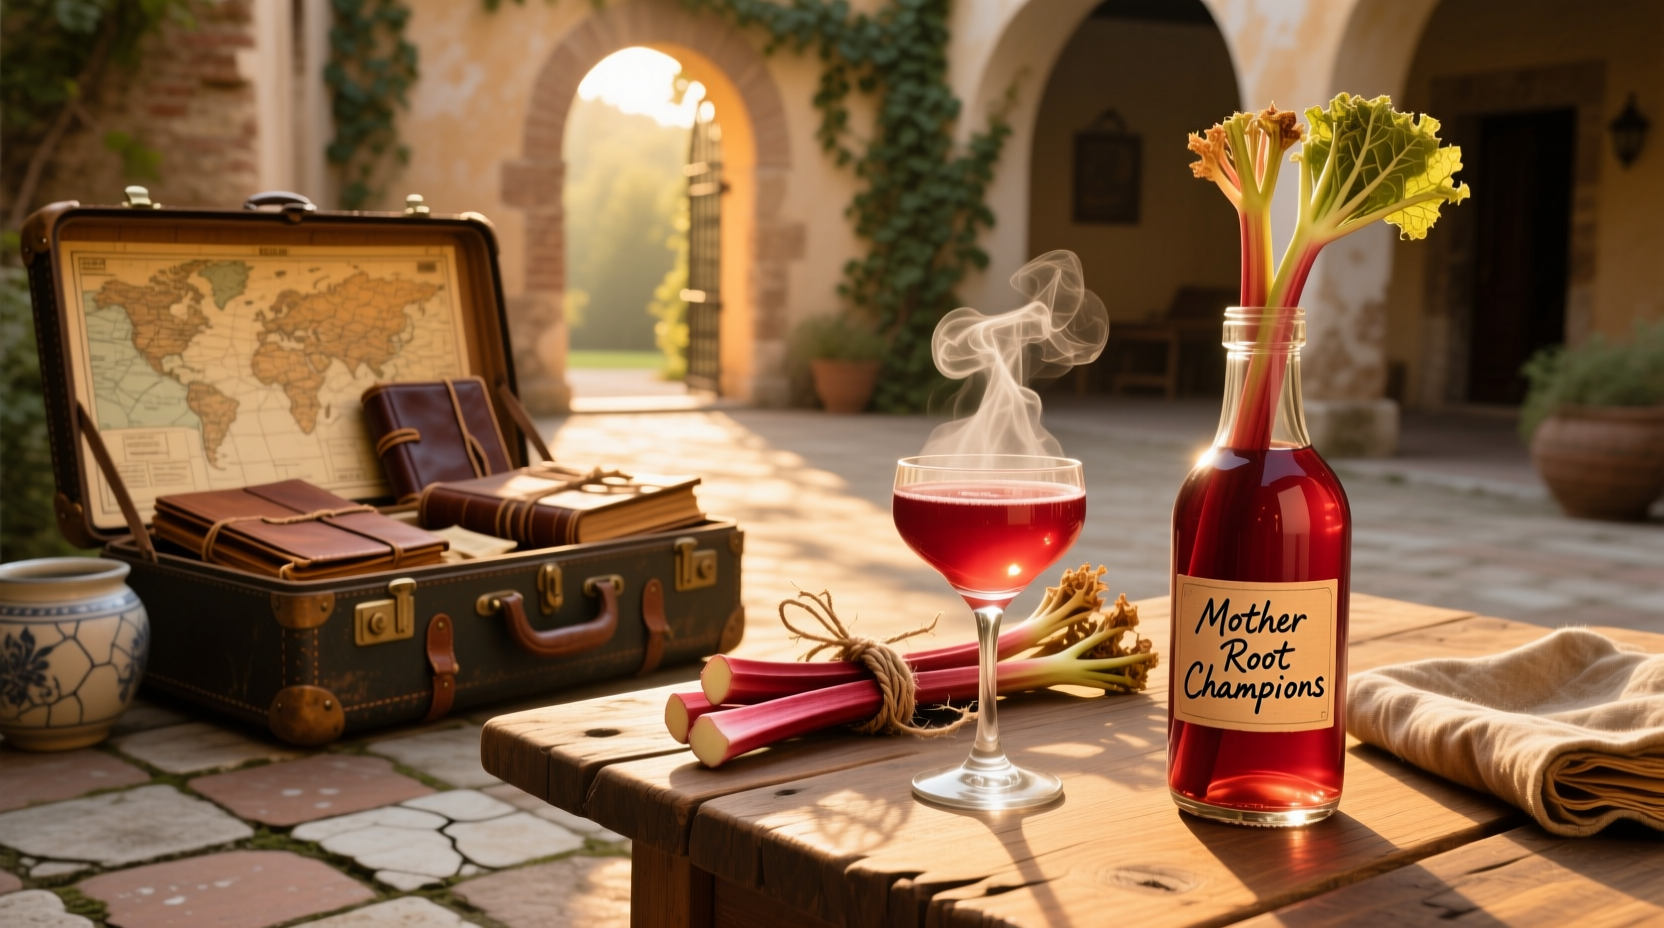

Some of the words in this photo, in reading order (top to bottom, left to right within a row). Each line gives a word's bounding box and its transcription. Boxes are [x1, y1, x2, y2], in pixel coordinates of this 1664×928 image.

[1194, 597, 1308, 637] Mother
[1219, 638, 1296, 673] Root
[1184, 661, 1325, 715] Champions
